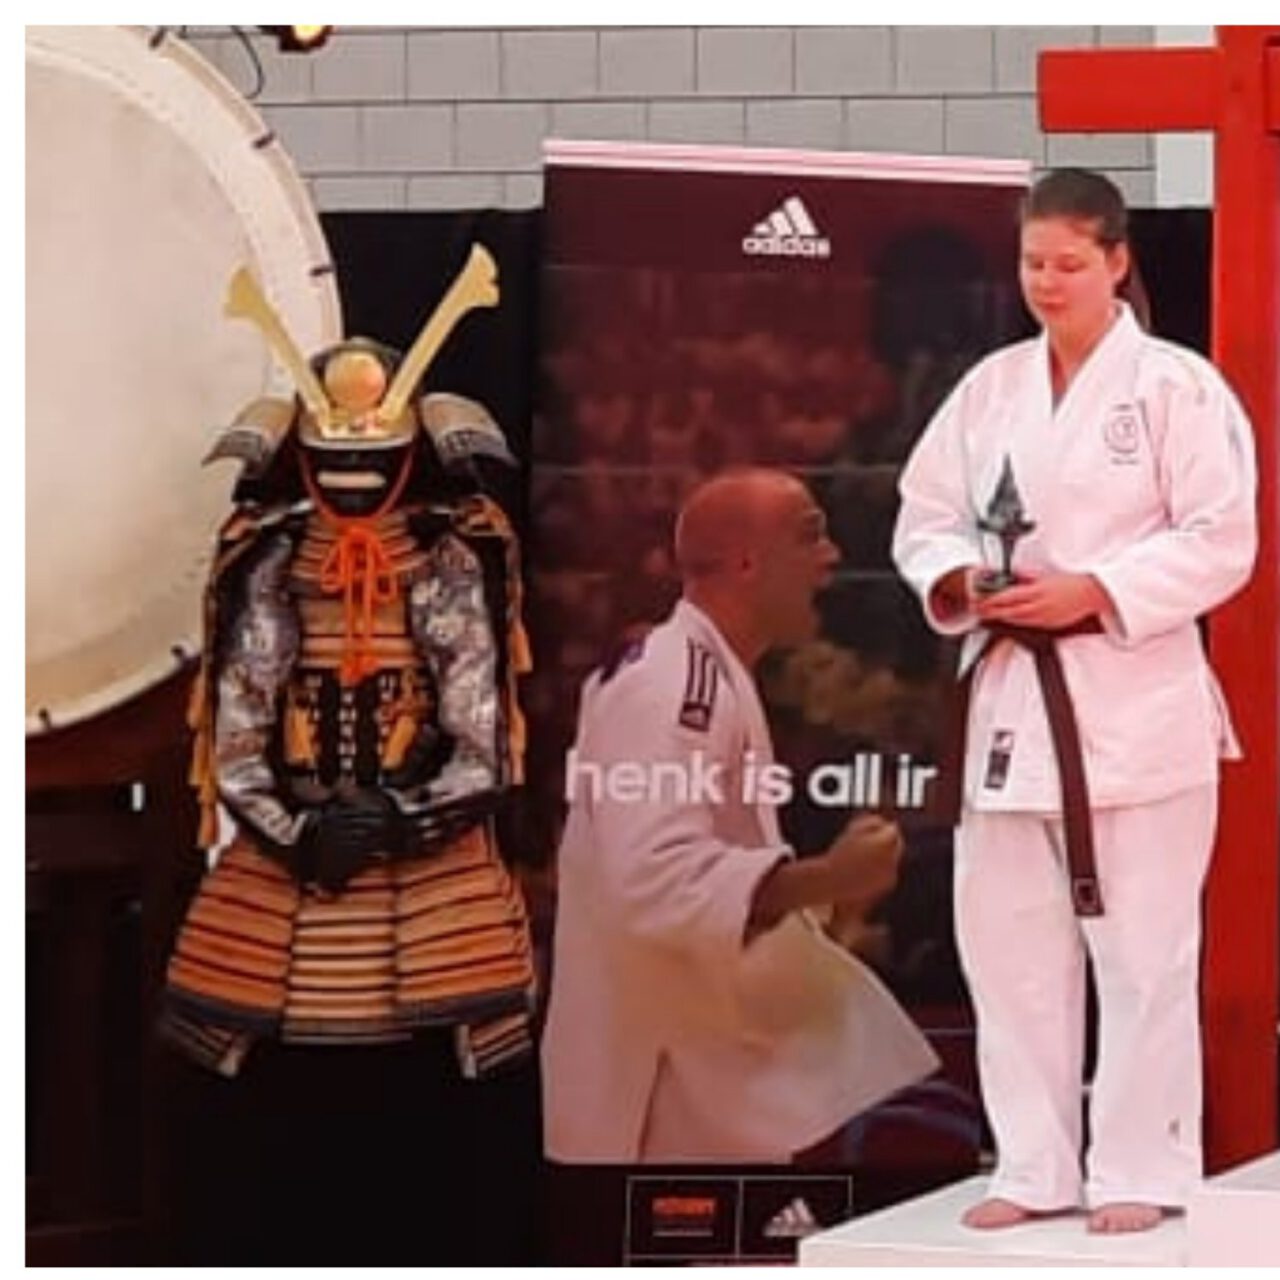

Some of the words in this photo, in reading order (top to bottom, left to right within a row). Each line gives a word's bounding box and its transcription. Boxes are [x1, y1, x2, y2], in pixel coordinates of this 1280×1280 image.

[566, 749, 725, 805] henk
[741, 752, 793, 806] is
[807, 753, 881, 808] all
